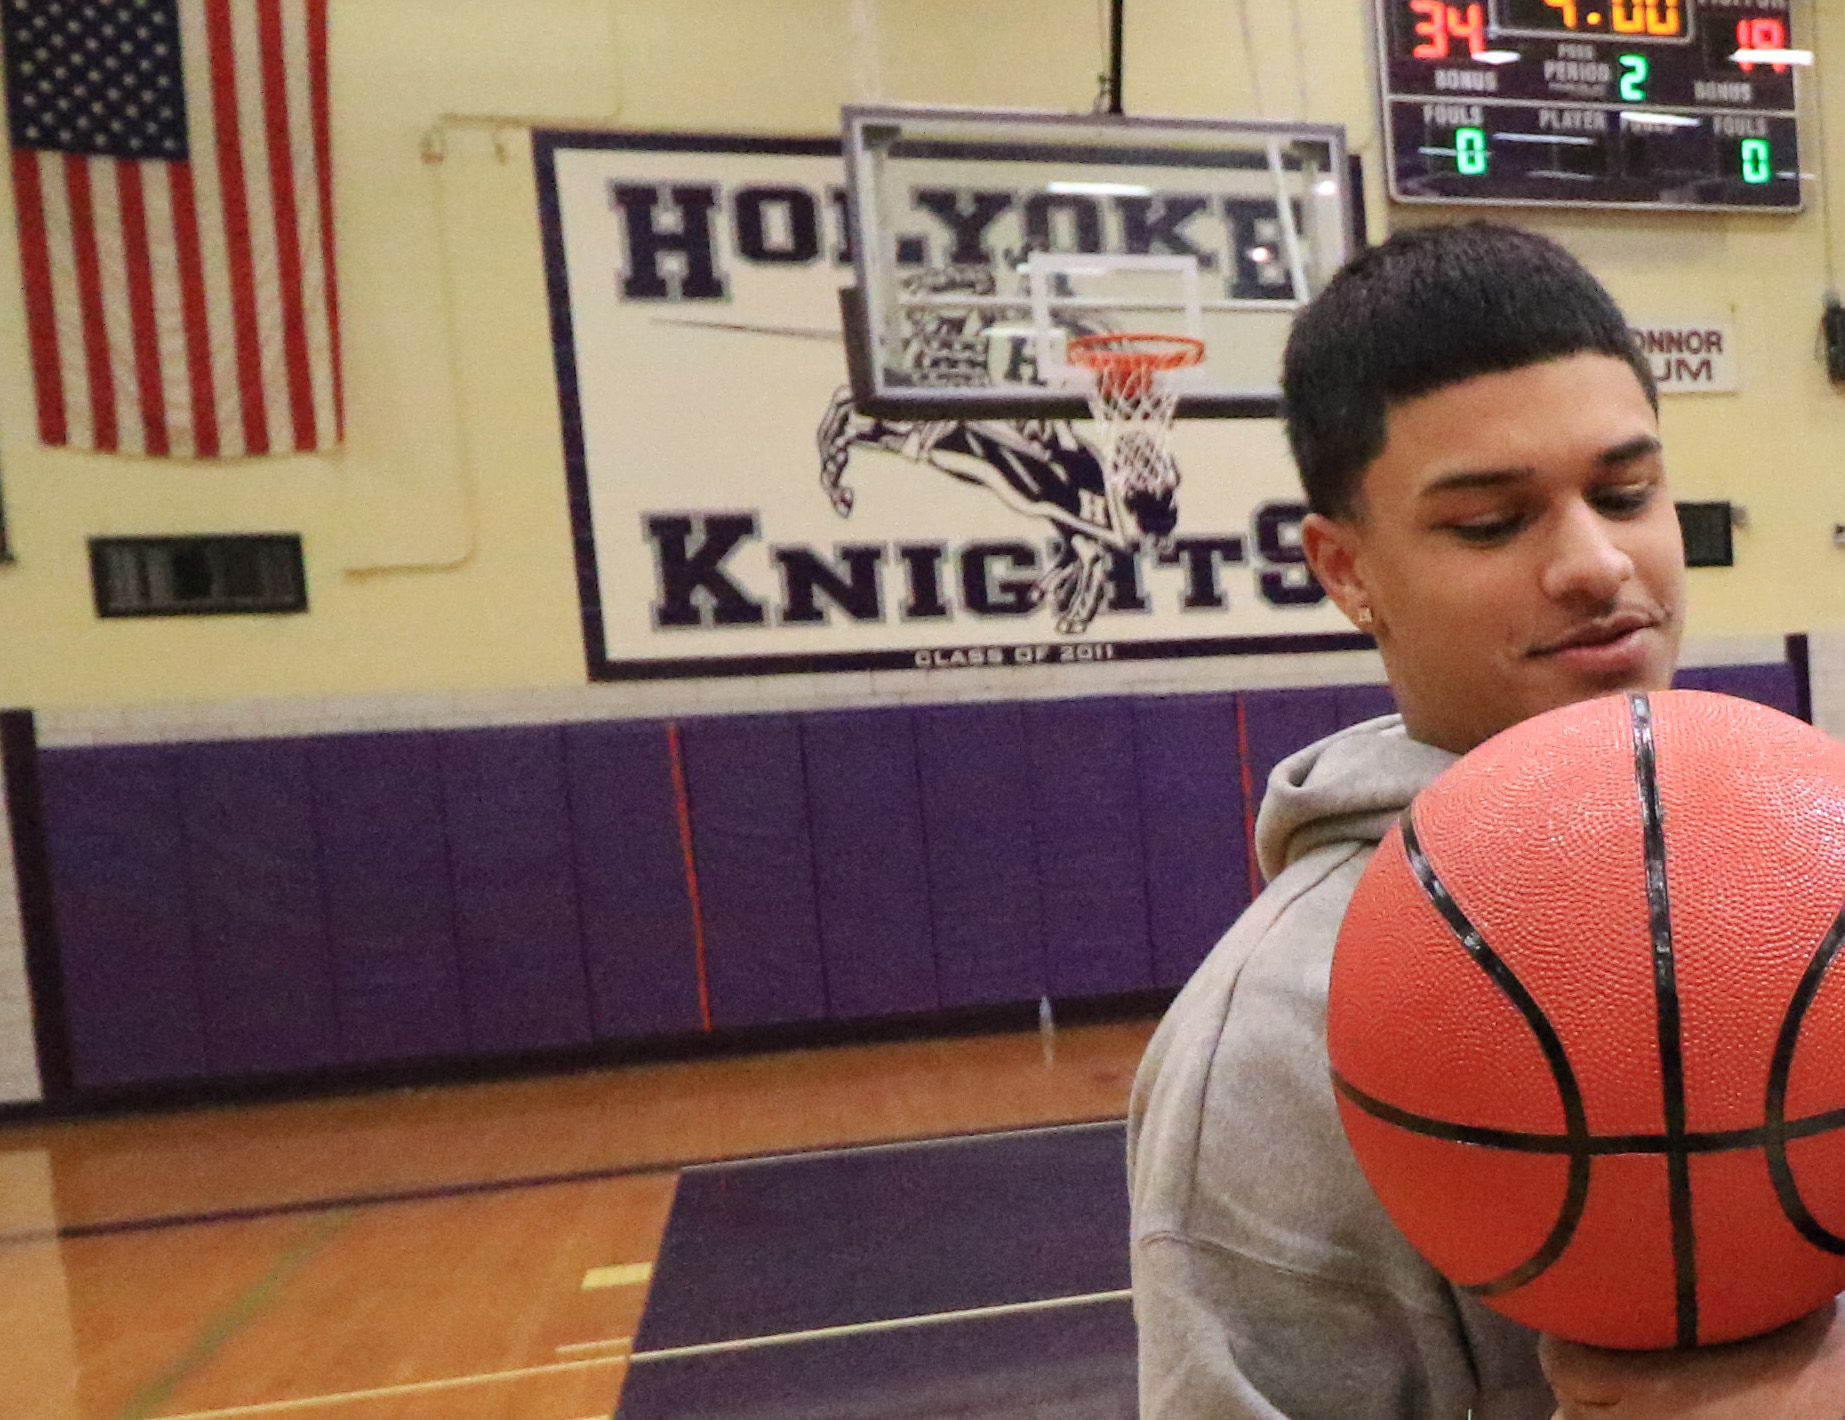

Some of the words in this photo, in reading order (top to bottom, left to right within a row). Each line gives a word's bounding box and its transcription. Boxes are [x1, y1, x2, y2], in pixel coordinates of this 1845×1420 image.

[1410, 0, 1486, 58] 34
[1618, 53, 1650, 101] 2
[1455, 128, 1488, 174] 0
[1741, 139, 1772, 183] 0
[914, 647, 1003, 668] CLASS
[1014, 645, 1049, 664] OF
[1060, 643, 1114, 662] 2011
